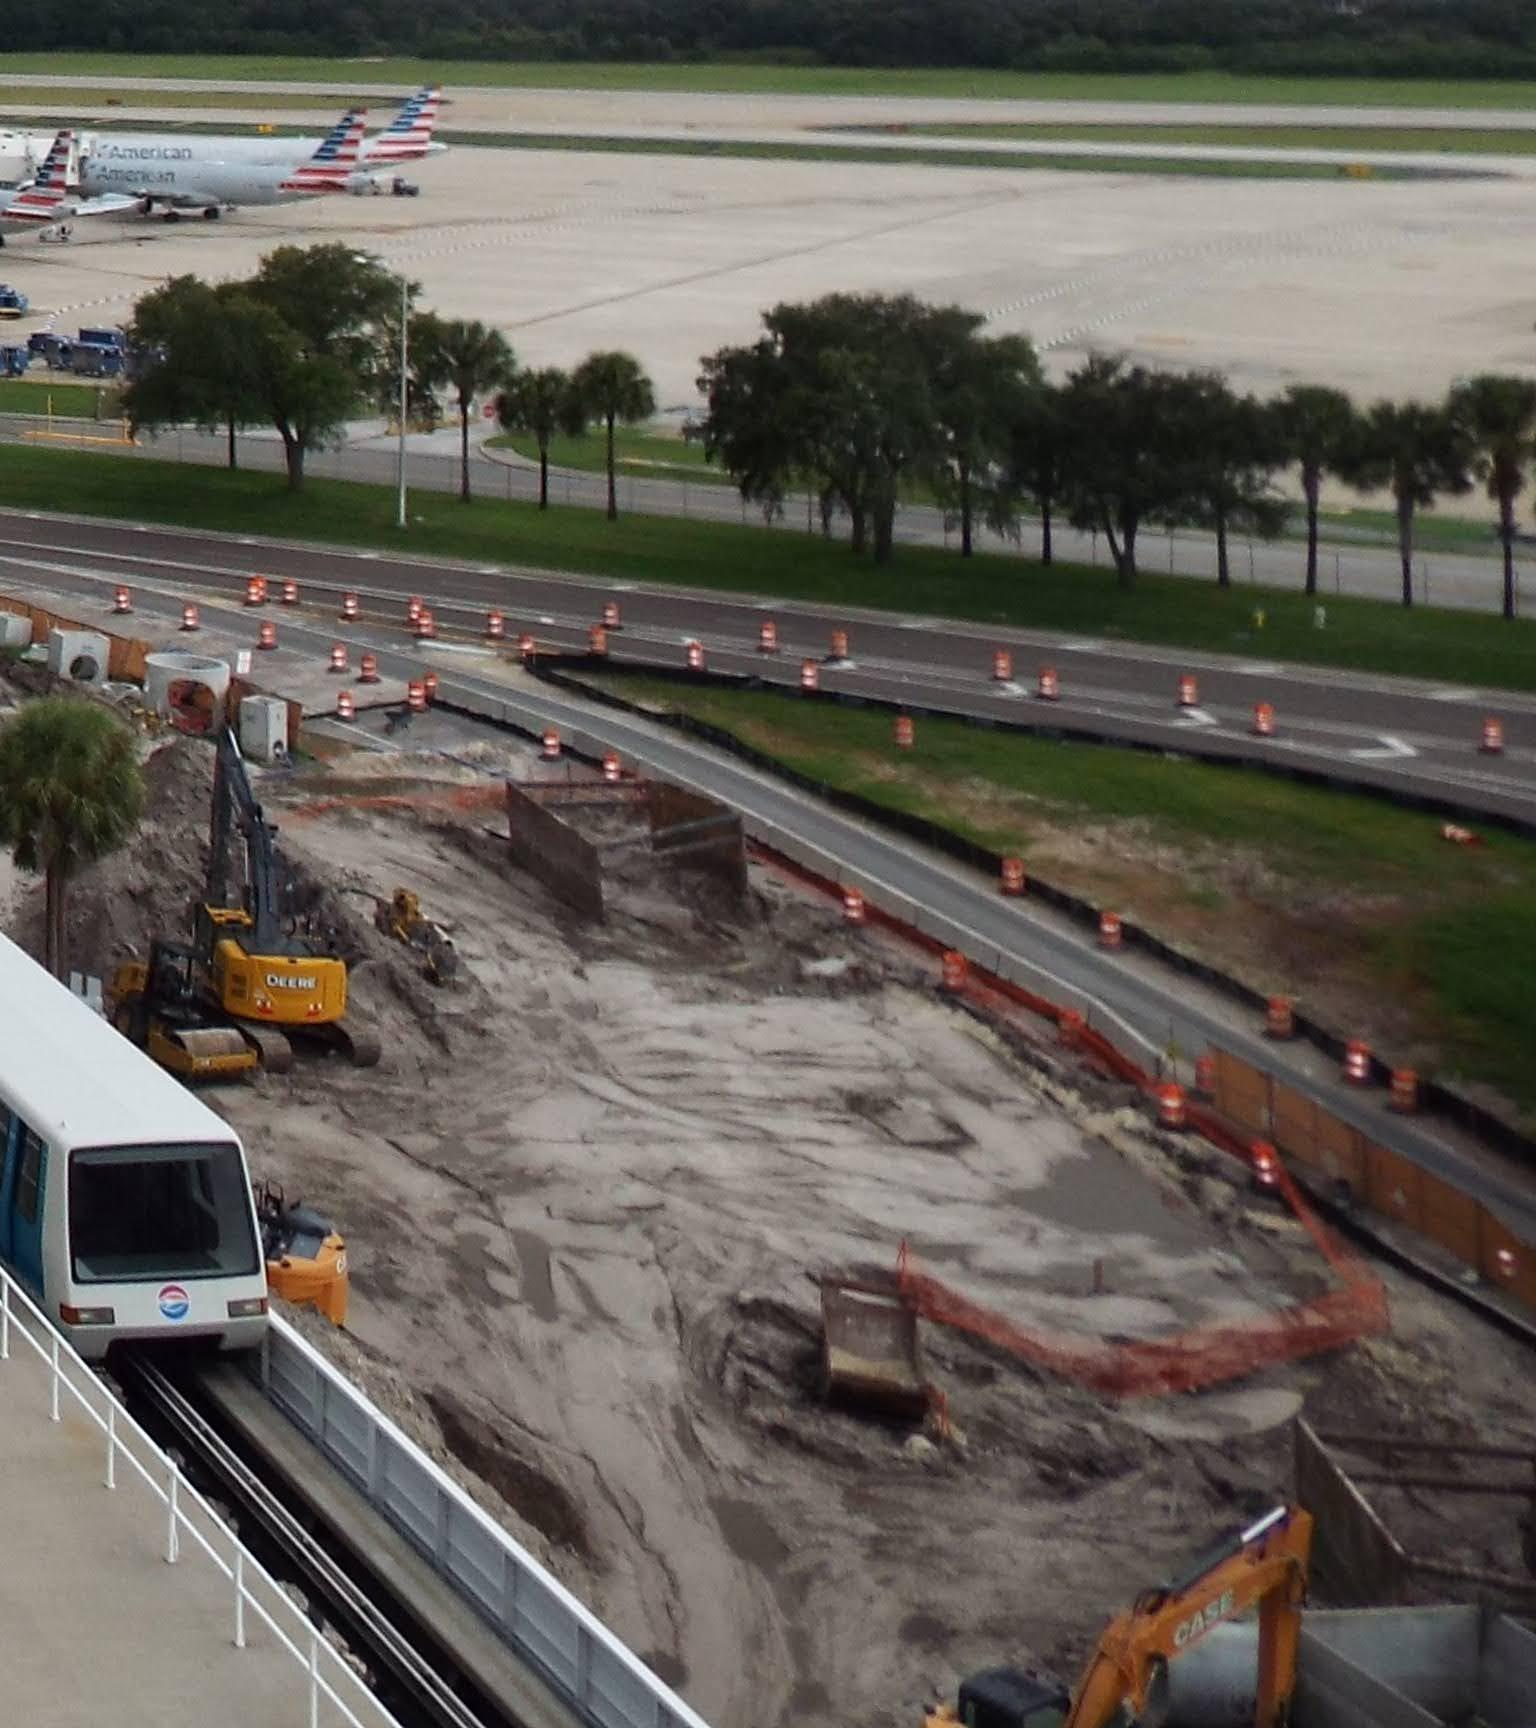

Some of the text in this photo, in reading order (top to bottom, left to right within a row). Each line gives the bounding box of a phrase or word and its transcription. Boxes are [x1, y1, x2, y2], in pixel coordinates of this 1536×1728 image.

[110, 146, 192, 160] American
[96, 166, 175, 184] American
[267, 974, 316, 989] DEERE
[1174, 1589, 1232, 1646] CASE
